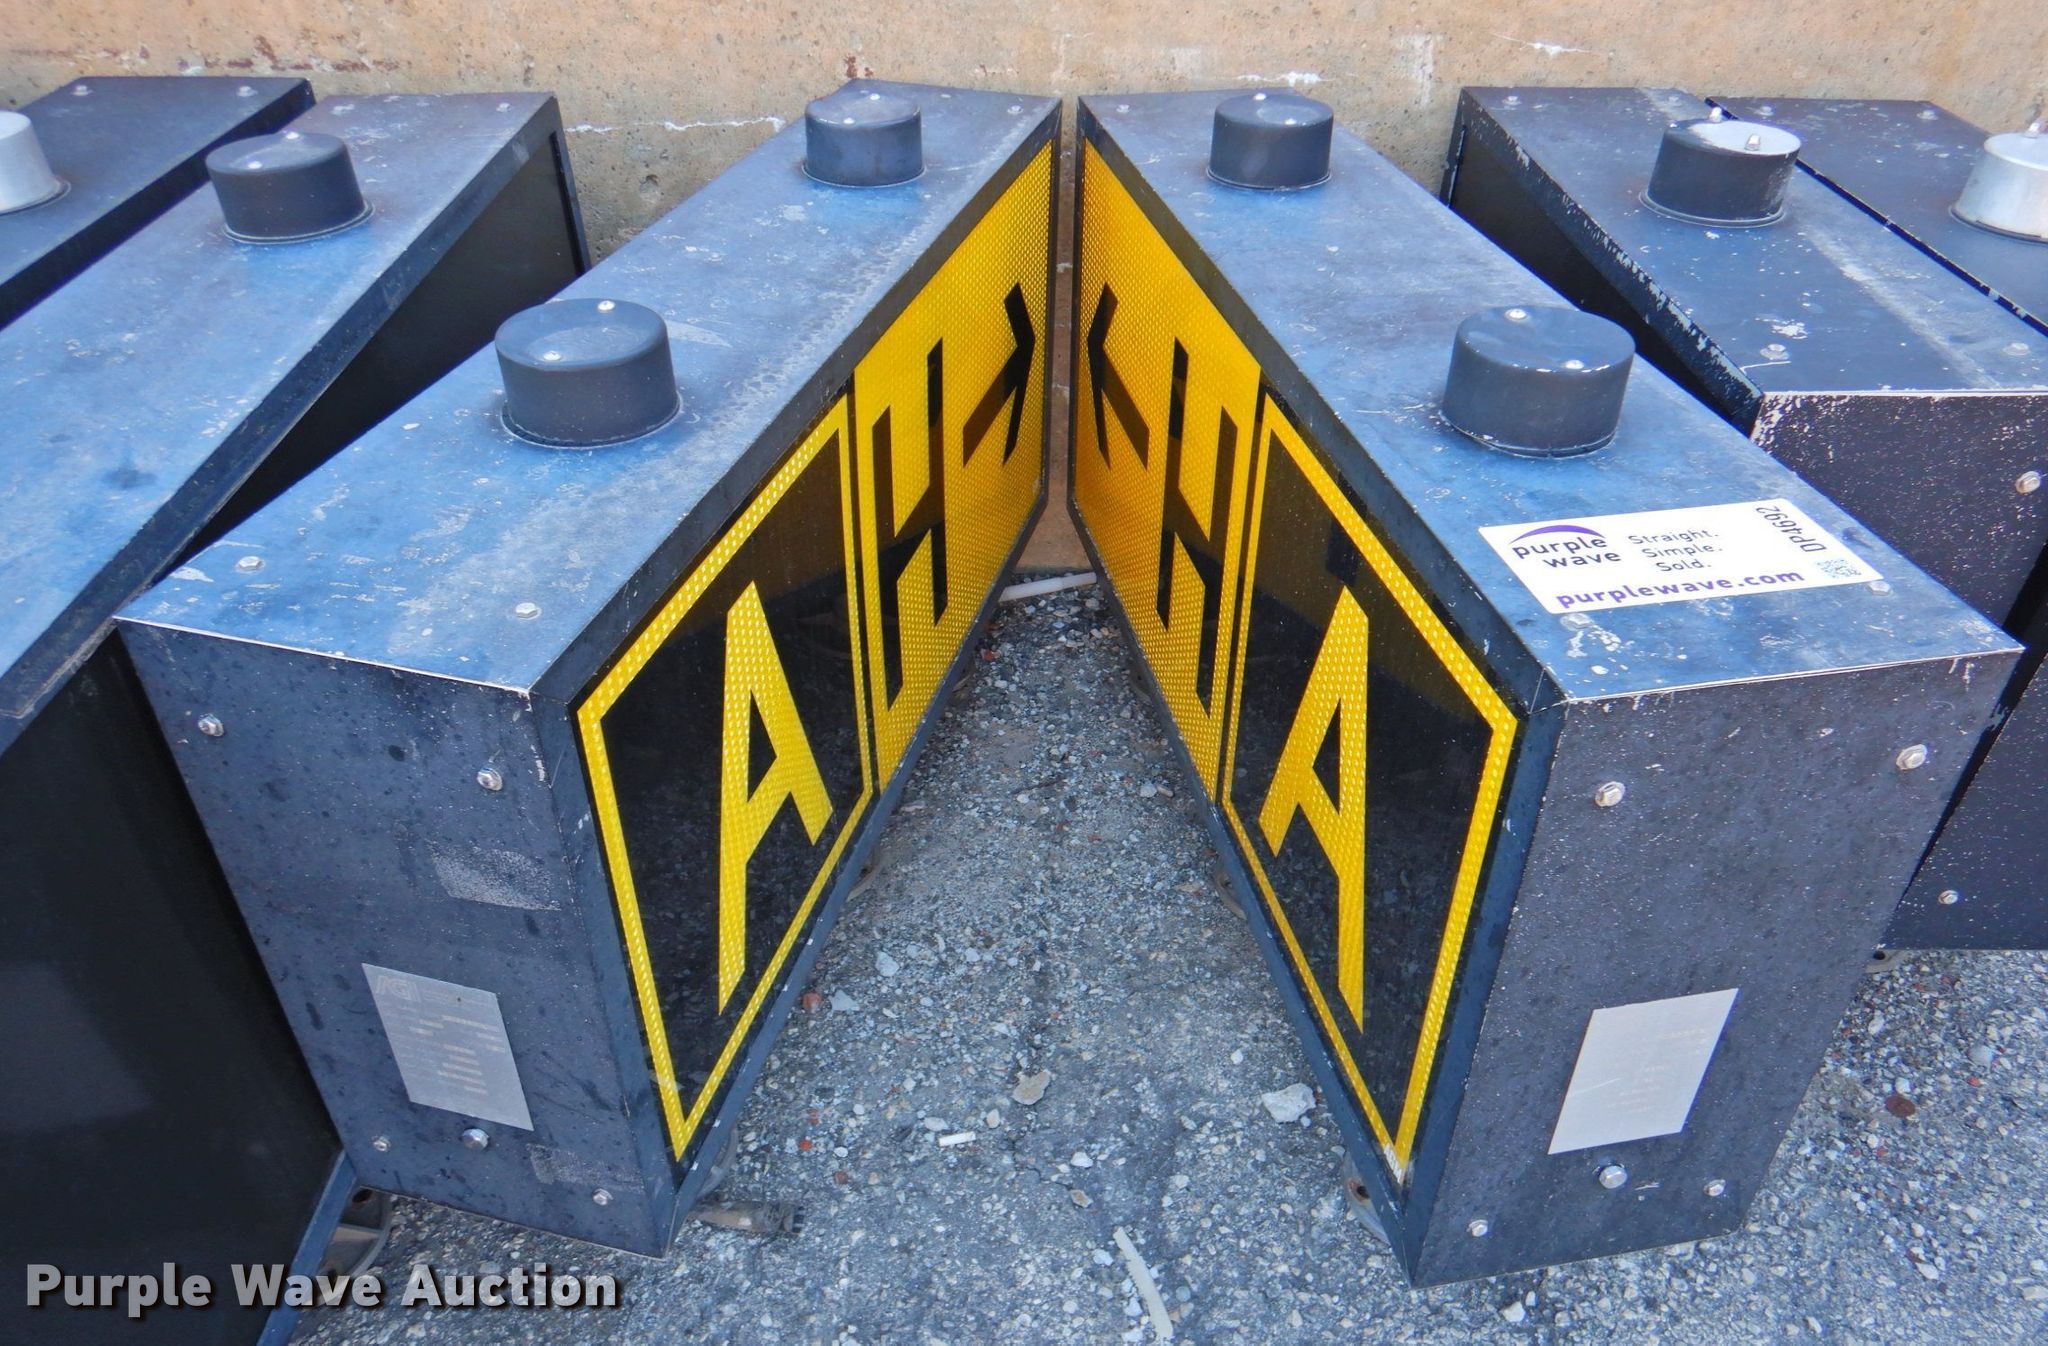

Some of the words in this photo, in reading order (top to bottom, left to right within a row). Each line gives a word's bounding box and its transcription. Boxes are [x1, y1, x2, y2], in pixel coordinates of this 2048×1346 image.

[1627, 528, 1720, 545] Straight.
[1512, 536, 1608, 560] purple
[1641, 543, 1723, 559] Simple.
[1542, 552, 1622, 568] wave
[1655, 559, 1712, 573] Sold.
[1556, 571, 1805, 609] purplewave.com
[719, 581, 832, 1014] A
[1258, 585, 1368, 1033] A
